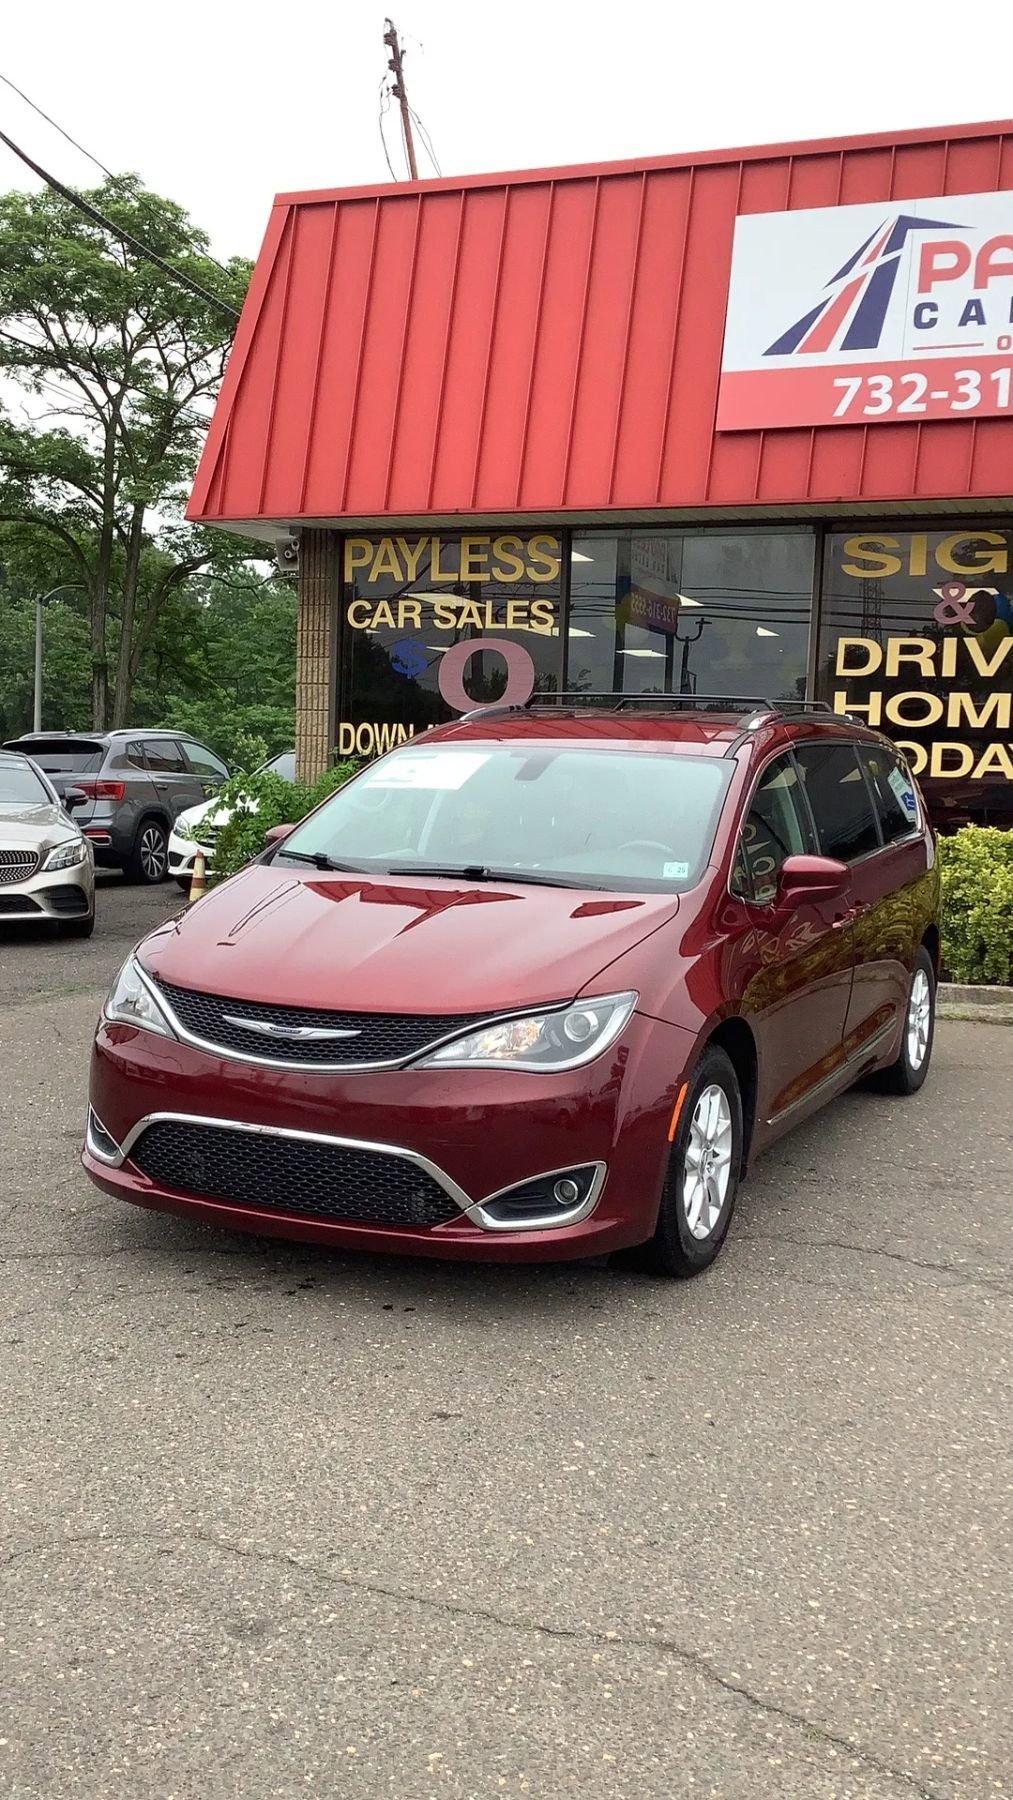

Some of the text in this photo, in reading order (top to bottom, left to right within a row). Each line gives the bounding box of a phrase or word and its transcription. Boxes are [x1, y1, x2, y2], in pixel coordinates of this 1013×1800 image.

[913, 297, 1013, 329] CA
[832, 367, 1011, 417] 732-31
[343, 534, 561, 583] PAYLESS
[841, 531, 1008, 578] SIG
[347, 600, 555, 631] CAR SALES
[933, 581, 977, 625] &
[835, 637, 1013, 677] DRIV
[834, 691, 1012, 728] HOM
